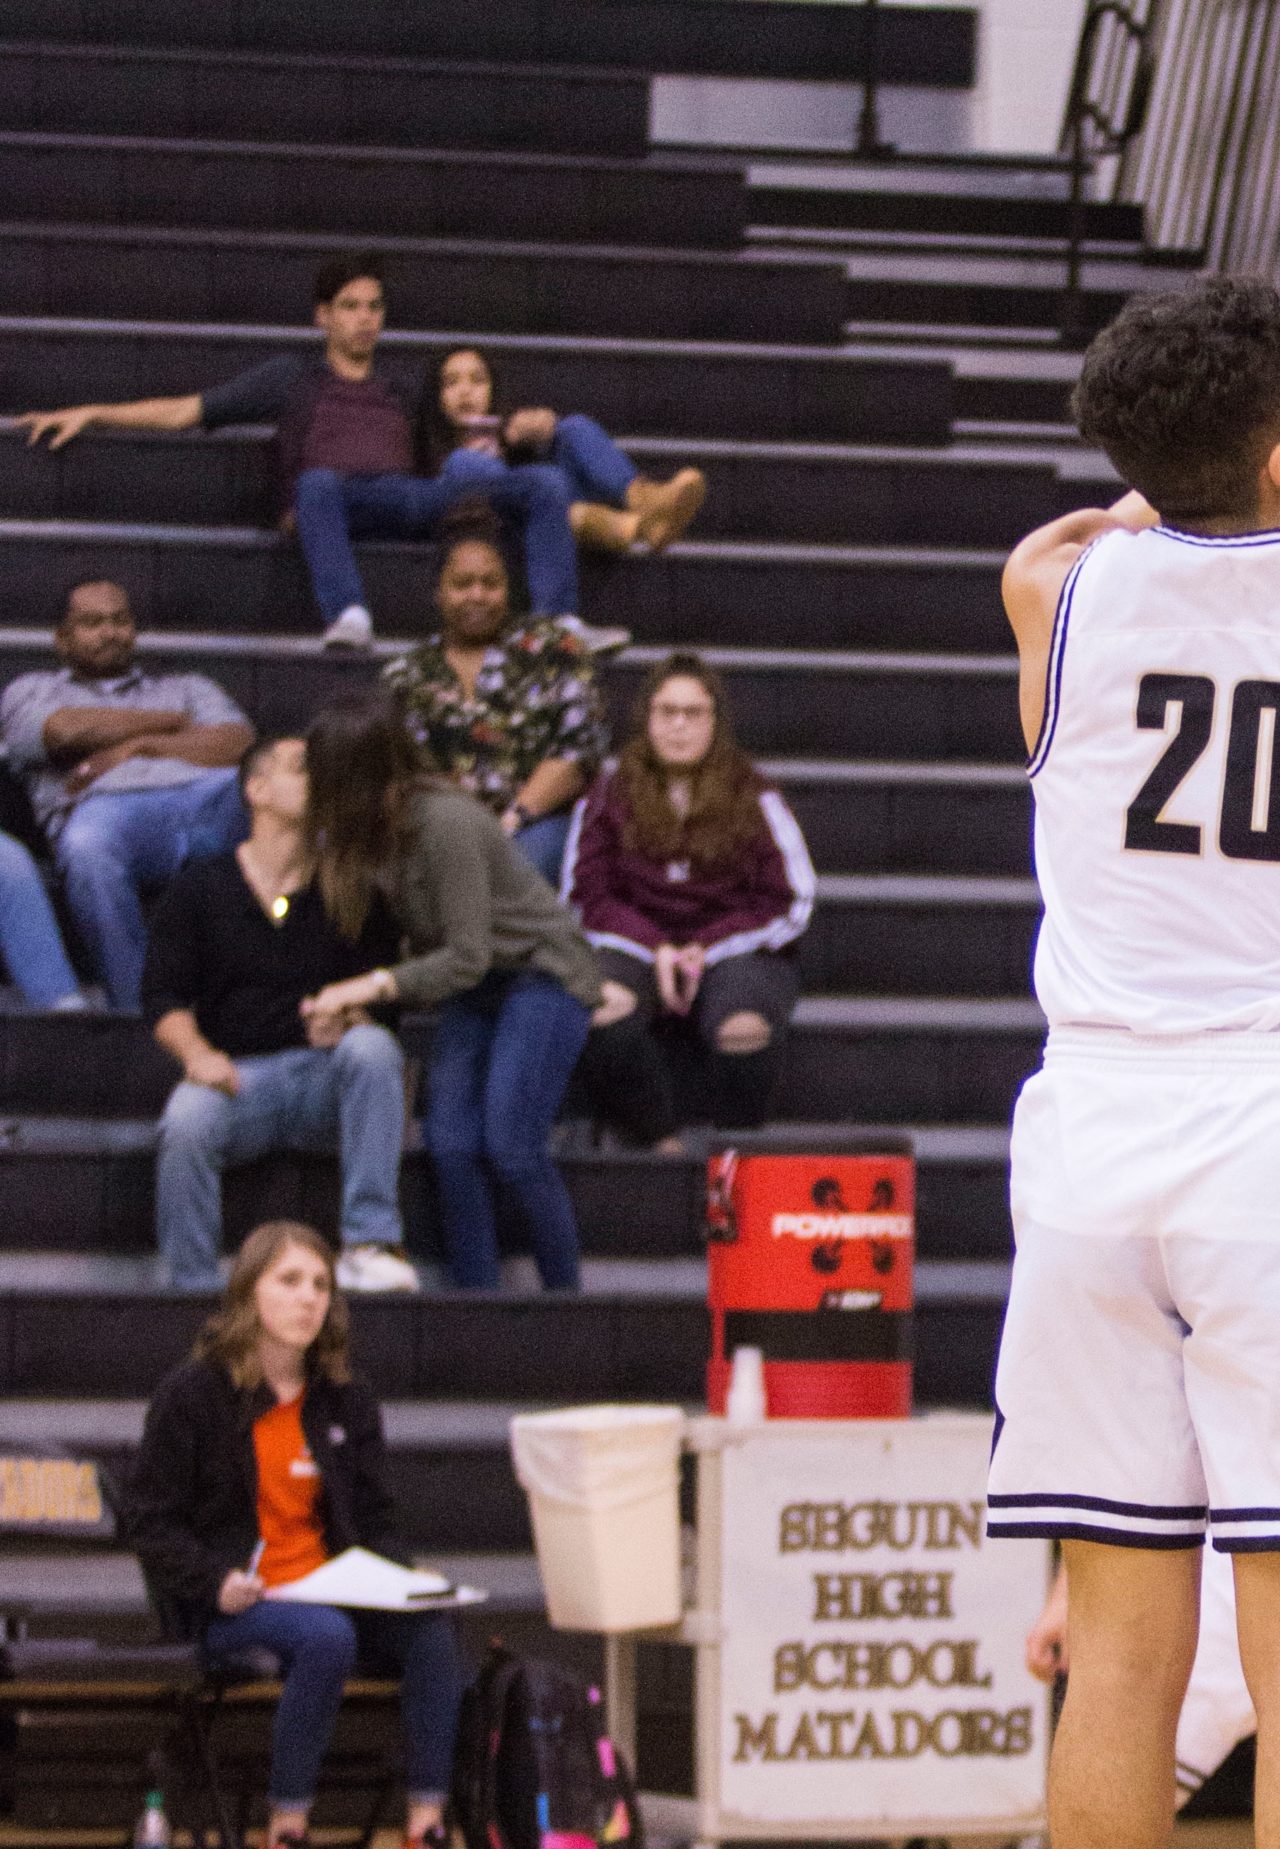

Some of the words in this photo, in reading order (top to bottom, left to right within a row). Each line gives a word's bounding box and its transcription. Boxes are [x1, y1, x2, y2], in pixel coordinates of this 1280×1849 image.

[779, 1500, 986, 1554] SEGUIN
[812, 1571, 954, 1622] HIGH
[773, 1638, 992, 1693] SCHOOL
[733, 1706, 1034, 1763] MATADORS
